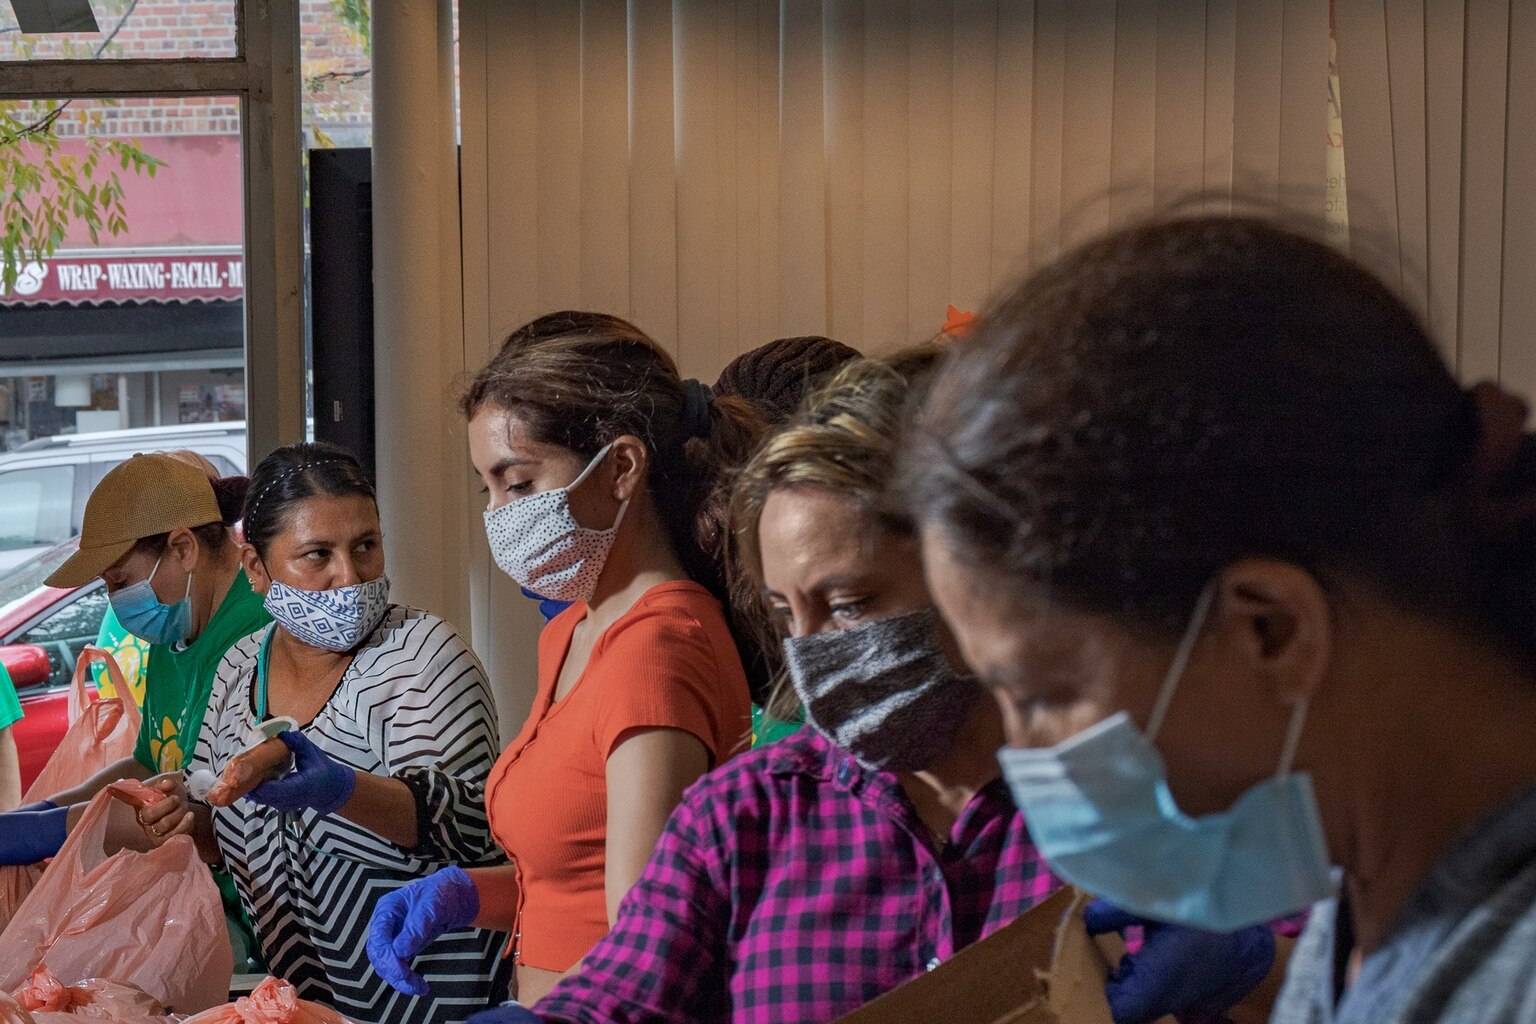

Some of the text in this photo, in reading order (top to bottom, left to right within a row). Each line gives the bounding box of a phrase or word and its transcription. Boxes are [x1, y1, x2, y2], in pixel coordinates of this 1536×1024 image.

[57, 264, 101, 290] WRAP
[107, 263, 164, 289] WAXING
[170, 262, 223, 288] FACIAL
